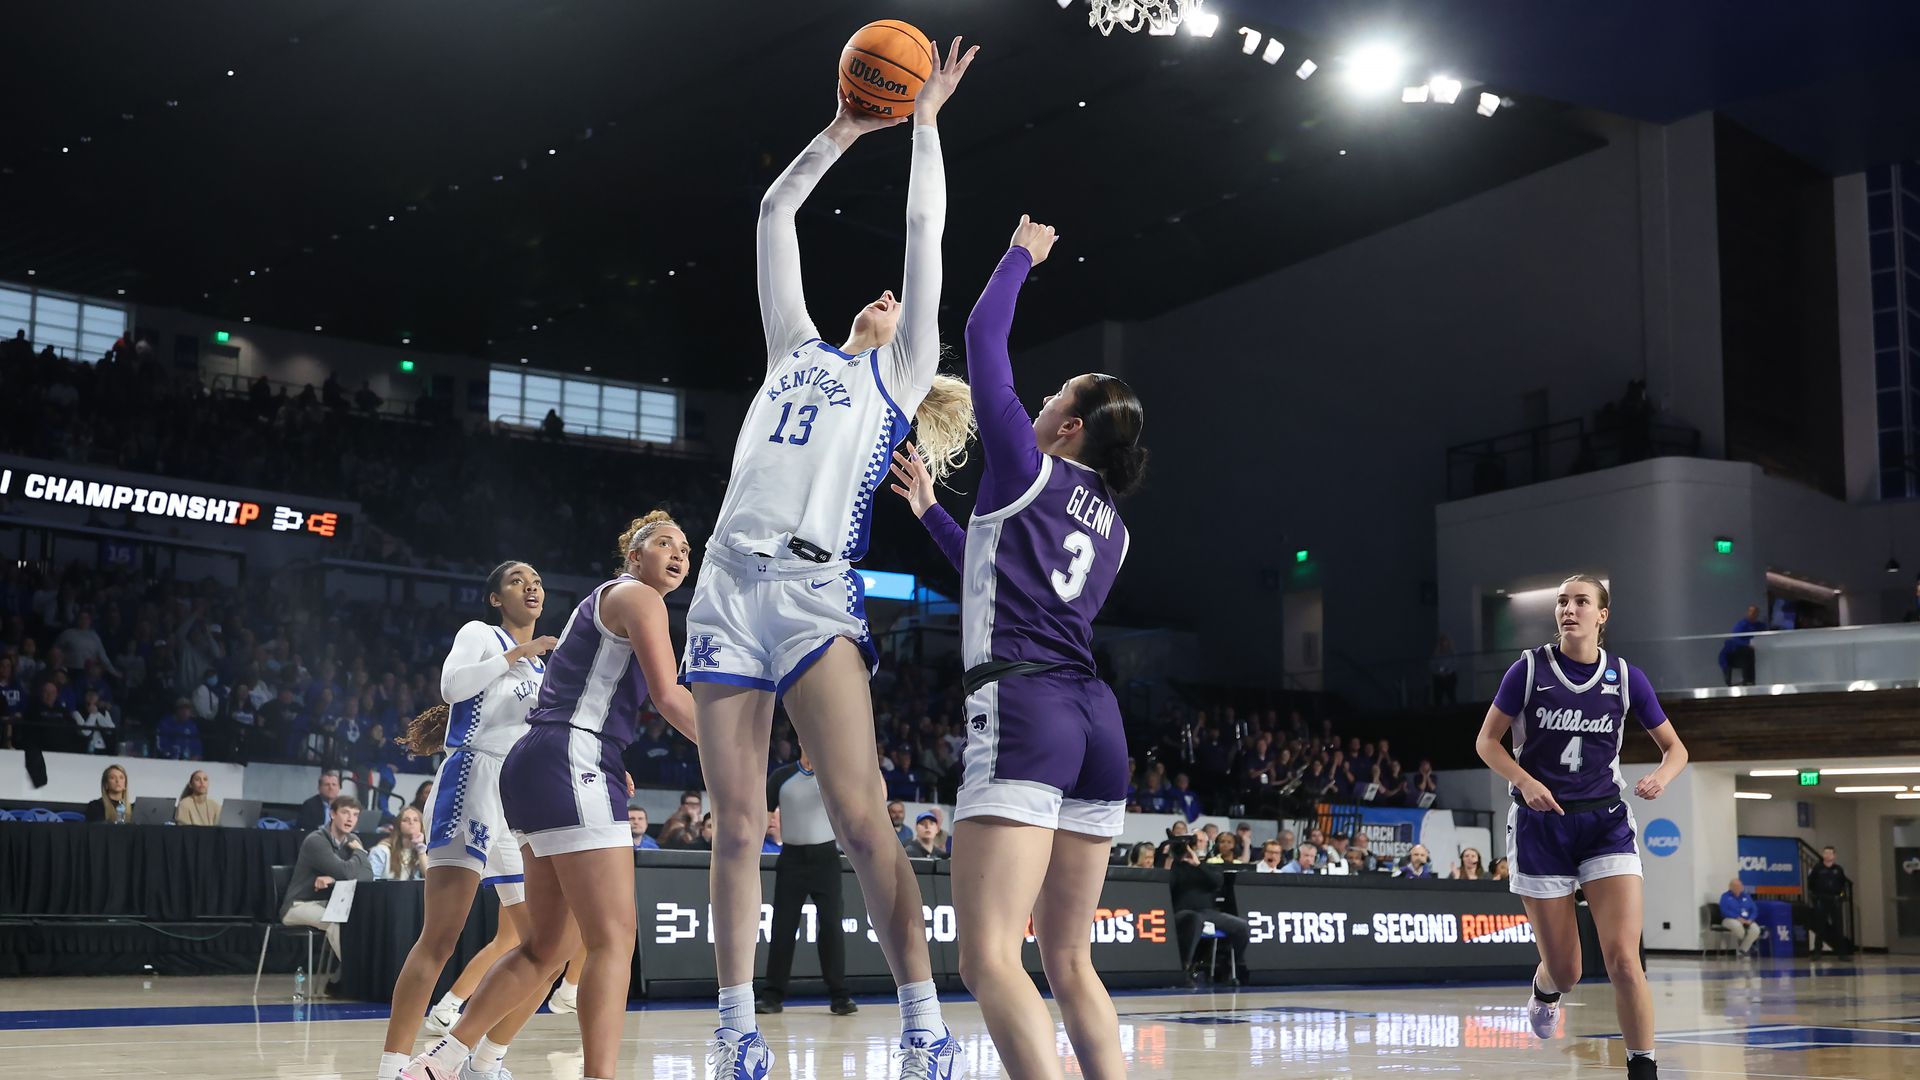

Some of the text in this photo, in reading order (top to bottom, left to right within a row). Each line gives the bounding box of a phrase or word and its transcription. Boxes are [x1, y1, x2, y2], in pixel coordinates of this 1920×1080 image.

[849, 56, 908, 96] Wilson
[767, 366, 851, 408] KENTUCKY
[768, 401, 818, 446] 13
[24, 473, 260, 526] CHAMPIONSHIP
[1066, 485, 1115, 540] GLENN
[1051, 530, 1096, 603] 3
[690, 635, 721, 668] UK
[513, 680, 539, 701] KENT
[1536, 706, 1613, 733] Wildcats
[1560, 736, 1583, 773] 4
[1801, 773, 1819, 786] EXIT
[469, 819, 490, 851] UK
[1647, 836, 1680, 847] NCAA
[1278, 912, 1348, 943] FIRST
[1372, 913, 1458, 944] SECOND
